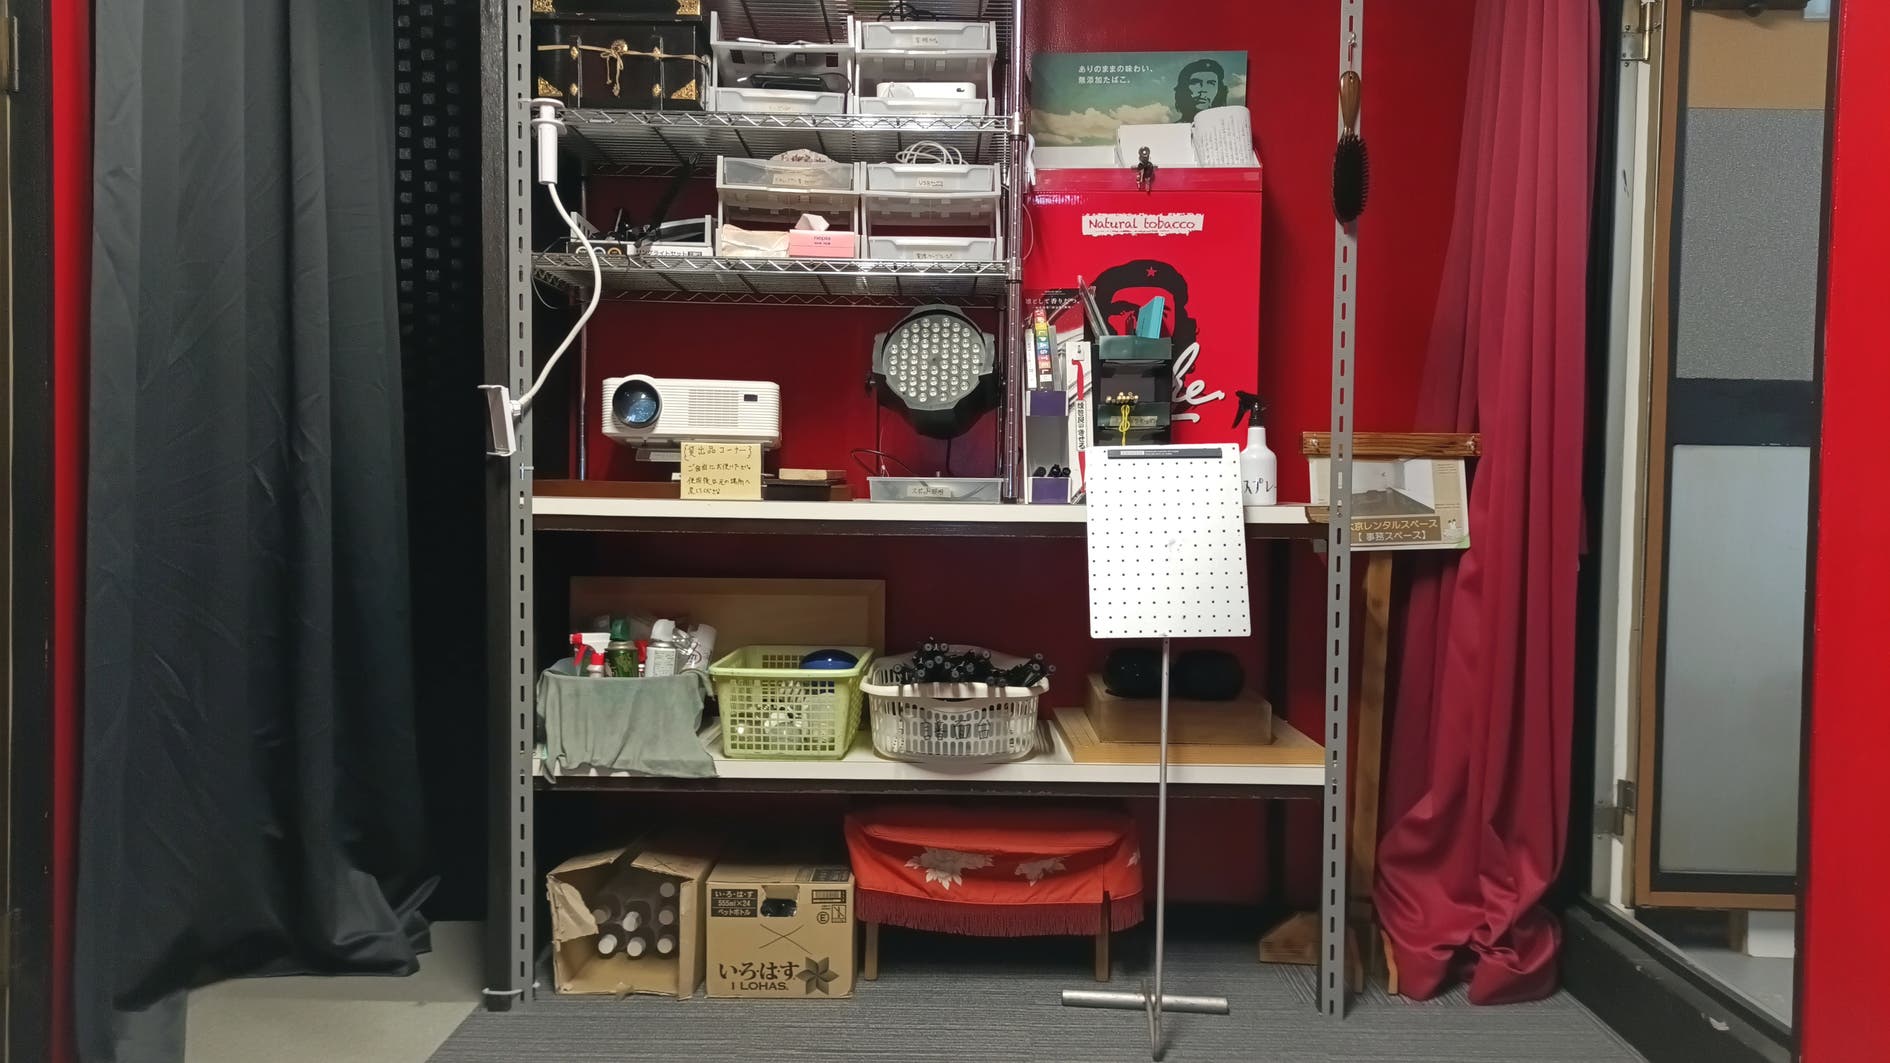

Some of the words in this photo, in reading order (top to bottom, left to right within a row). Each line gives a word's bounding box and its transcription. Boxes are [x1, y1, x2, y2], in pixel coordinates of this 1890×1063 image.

[1078, 65, 1153, 73] ありのままの味わい、
[1078, 76, 1131, 84] 無添加たばこ。
[1089, 217, 1137, 229] Natural
[1144, 216, 1195, 229] tobacco
